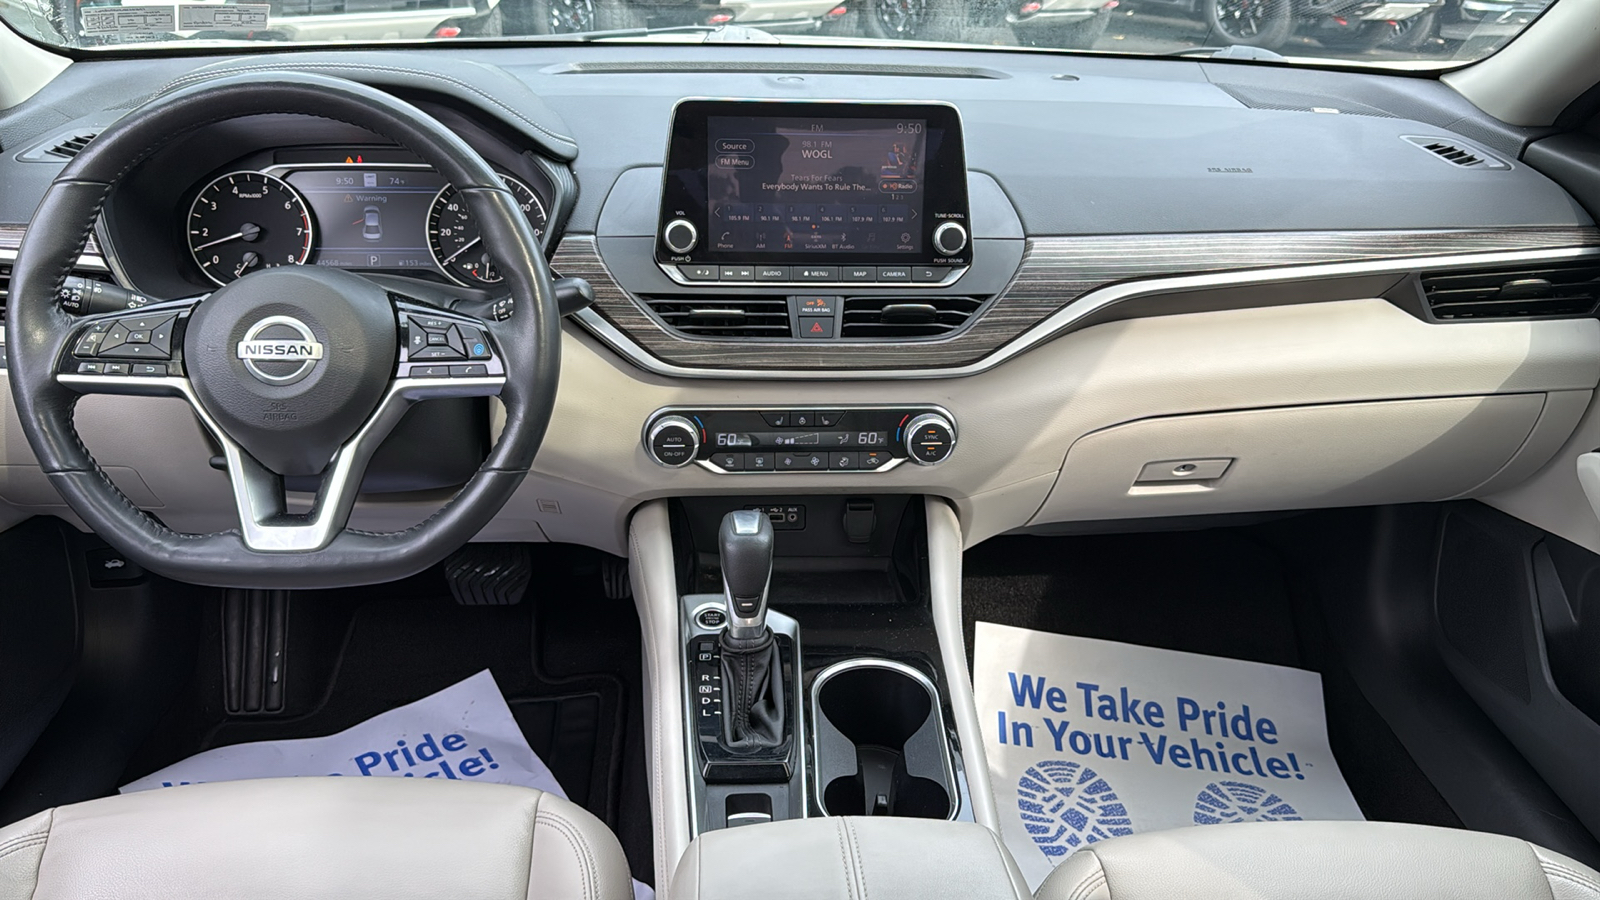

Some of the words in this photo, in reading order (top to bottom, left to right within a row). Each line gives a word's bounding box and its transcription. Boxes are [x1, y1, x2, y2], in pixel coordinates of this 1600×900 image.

[811, 124, 824, 132] FM
[896, 123, 922, 134] 9:50
[722, 142, 747, 150] Source
[801, 149, 833, 159] WOGL
[720, 158, 730, 166] FM
[731, 158, 750, 166] Menu
[335, 177, 354, 185] 9:50
[232, 186, 239, 195] 4
[262, 186, 269, 194] 5
[762, 183, 799, 192] Everybody
[800, 183, 823, 191] Wants
[355, 194, 388, 203] Warning
[211, 202, 217, 210] 3
[284, 201, 291, 209] 6
[447, 203, 459, 212] 40
[202, 228, 209, 237] 2
[296, 228, 302, 236] 7
[212, 255, 219, 264] 0
[288, 254, 295, 263] 8
[370, 255, 378, 266] P
[62, 300, 80, 308] AUTO
[245, 345, 313, 356] NISSAN
[263, 412, 298, 421] AIRBAG
[717, 433, 737, 446] 60
[858, 432, 878, 444] 60
[1008, 671, 1067, 713] We
[1076, 681, 1165, 728] Take
[1176, 696, 1279, 745] Pride
[997, 710, 1033, 748] In
[1043, 717, 1132, 760] Your
[1142, 732, 1306, 781] Vehicle!
[354, 733, 469, 776] Pride
